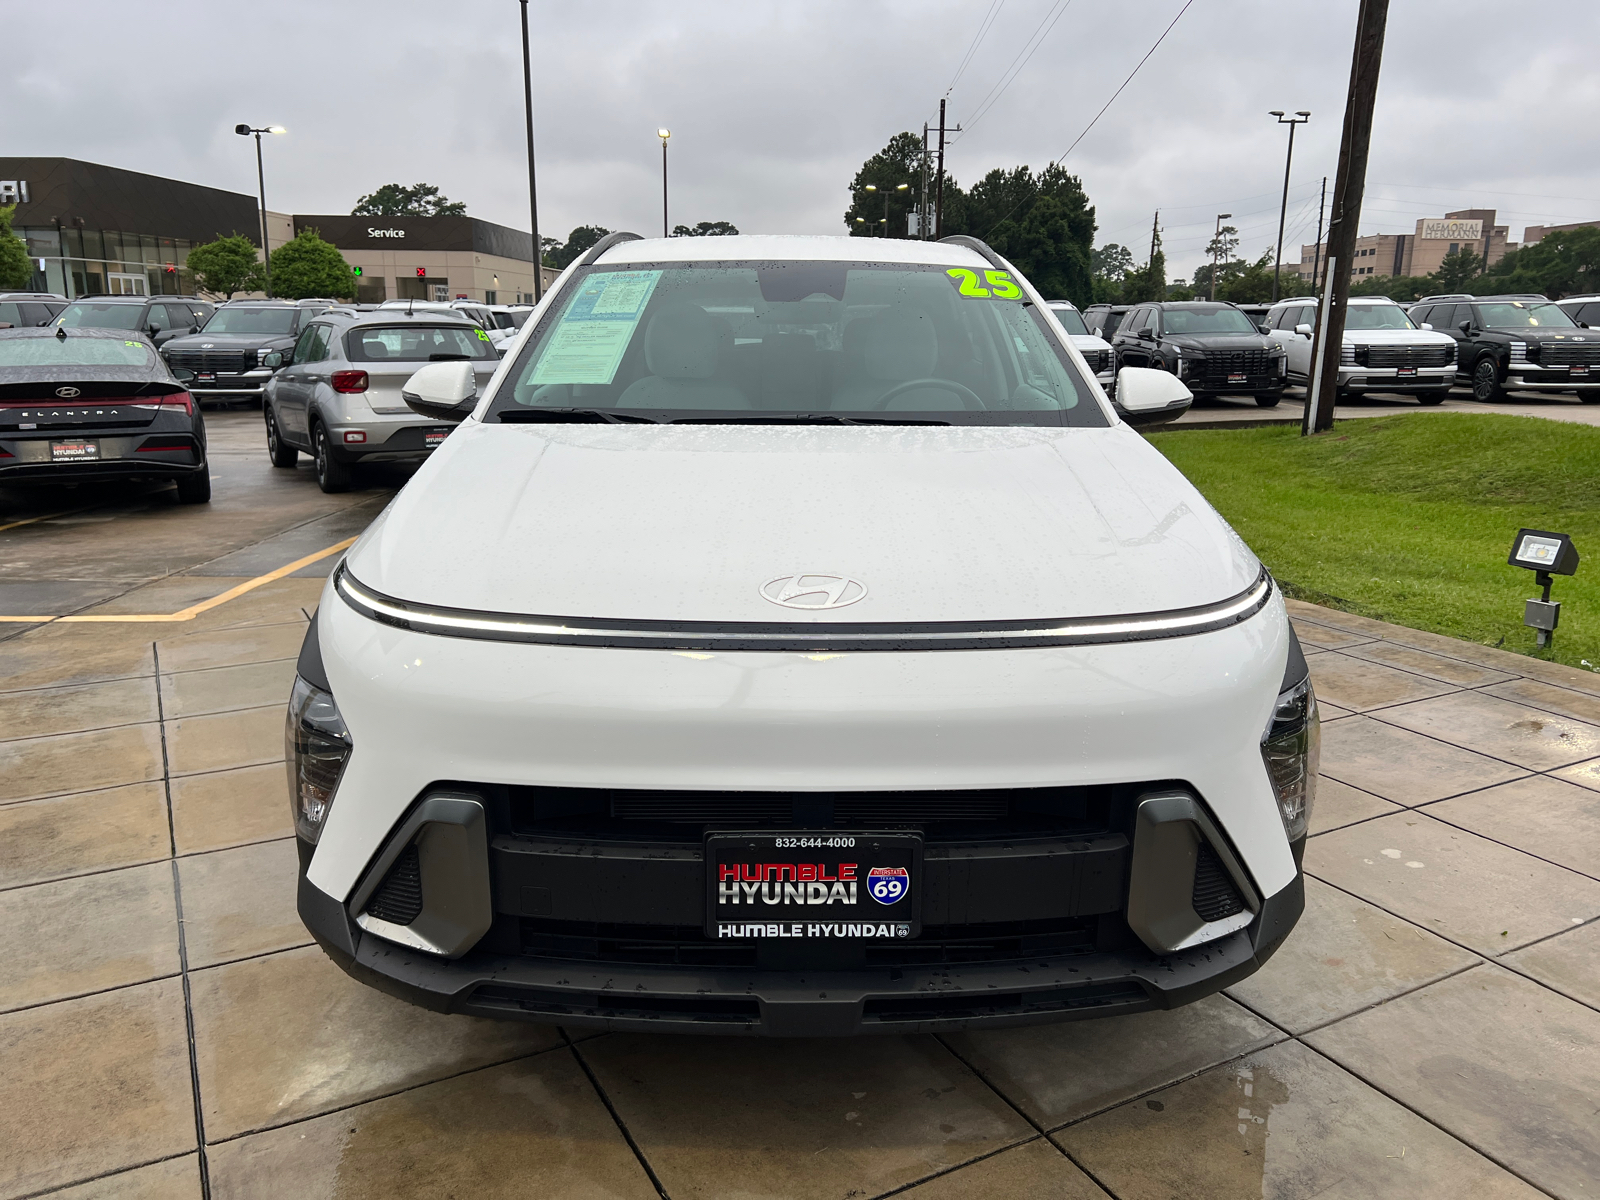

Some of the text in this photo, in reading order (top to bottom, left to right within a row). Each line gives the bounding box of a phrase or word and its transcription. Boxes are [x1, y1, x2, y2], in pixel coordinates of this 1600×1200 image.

[367, 227, 405, 238] Service
[1426, 223, 1479, 231] MEMORIAL
[1425, 230, 1479, 238] HERMANN
[946, 268, 1023, 300] 25
[474, 329, 490, 342] 25
[775, 838, 856, 848] 832-644-4000
[718, 863, 858, 881] HUMBLE
[718, 882, 858, 905] HYUNDAI
[873, 880, 902, 898] 69
[718, 924, 803, 938] HUMBLE
[807, 924, 895, 938] HYUNDAI
